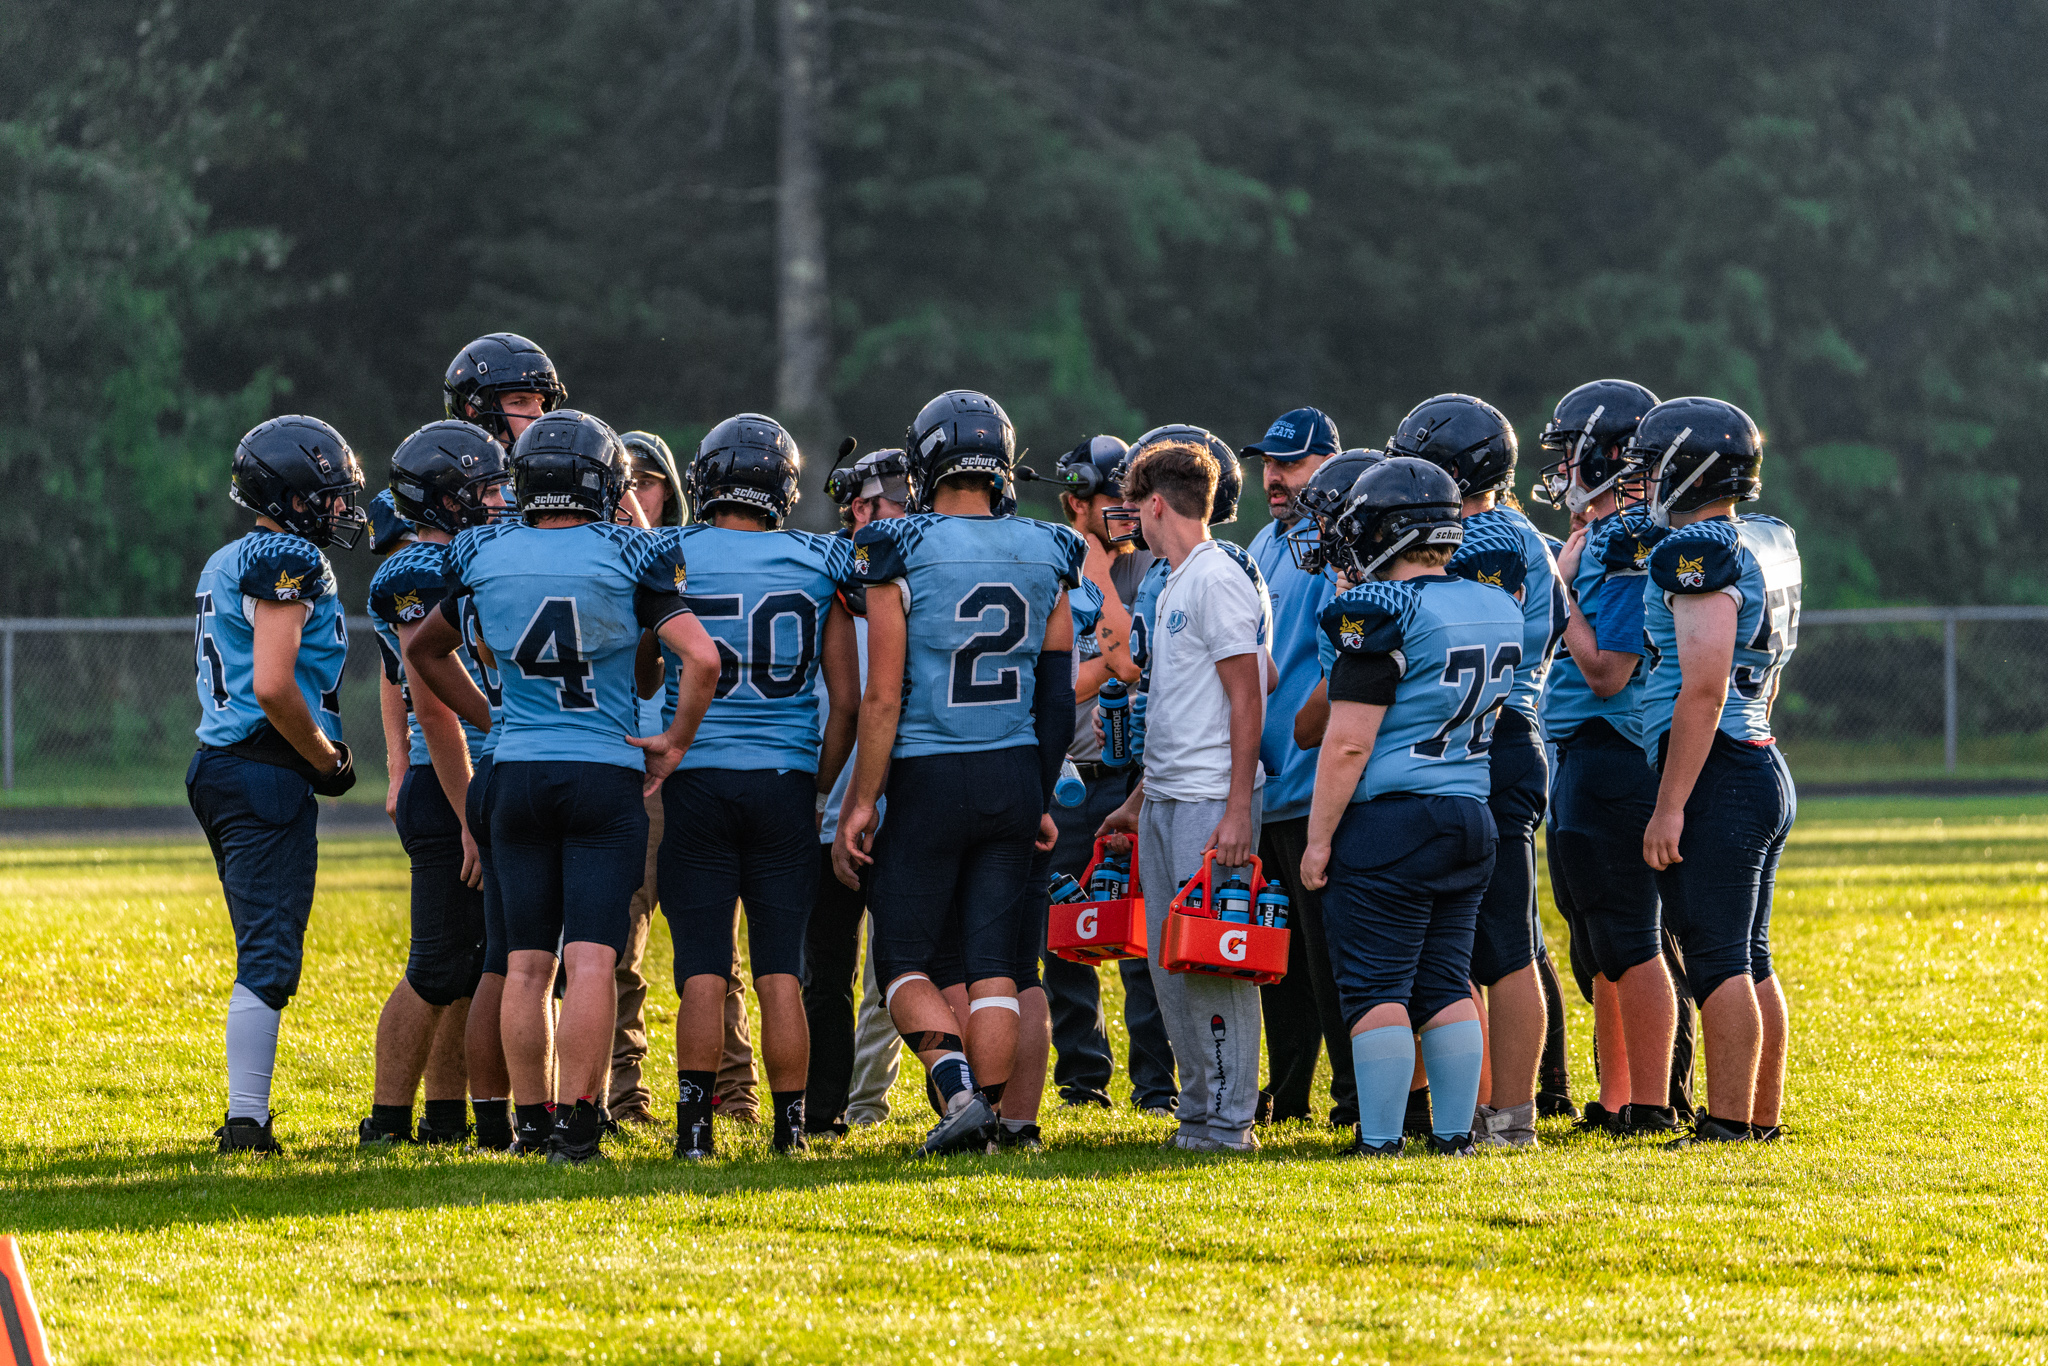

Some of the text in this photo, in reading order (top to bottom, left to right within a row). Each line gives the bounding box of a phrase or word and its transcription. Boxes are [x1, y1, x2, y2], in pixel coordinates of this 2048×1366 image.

[960, 455, 998, 467] schutt
[534, 493, 571, 504] schutt
[732, 487, 771, 502] schutt
[1436, 529, 1462, 540] schutt
[510, 597, 600, 711] 4
[675, 589, 819, 699] 50
[948, 582, 1029, 707] 2
[1410, 642, 1522, 760] 72
[1115, 709, 1124, 758] POWERADE
[1076, 907, 1098, 939] G
[1219, 929, 1248, 962] G
[1210, 1014, 1227, 1115] Champion
